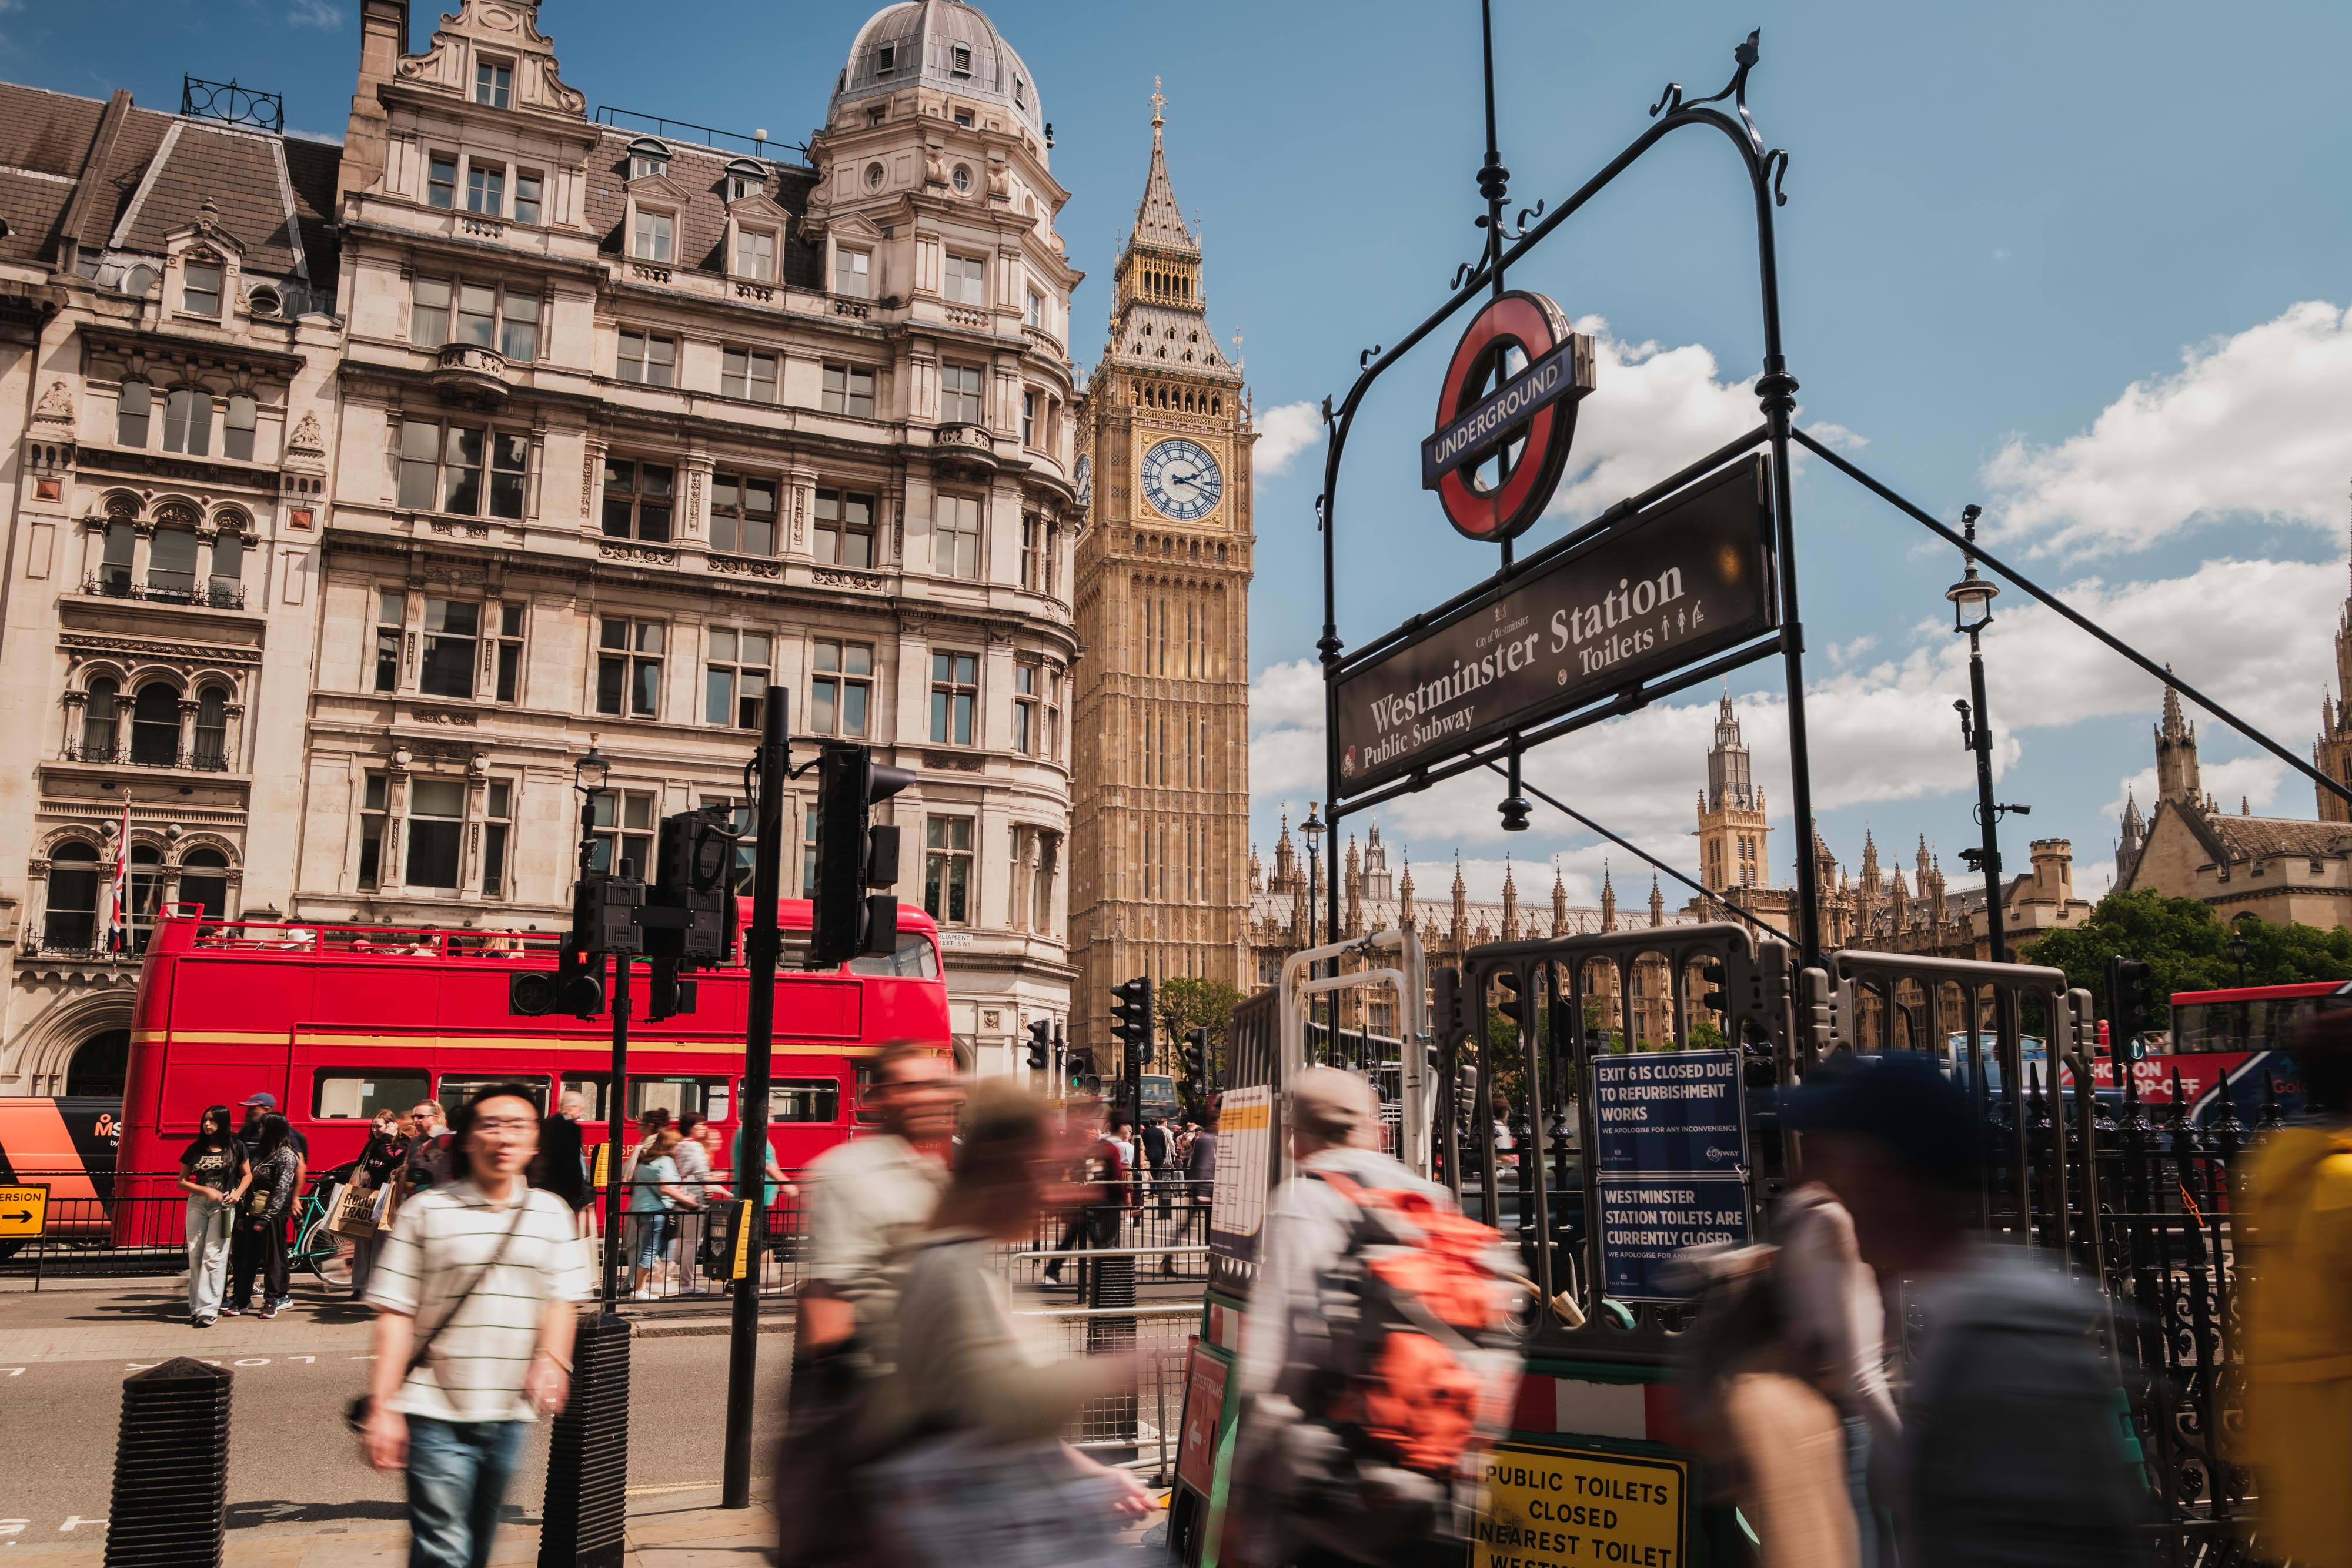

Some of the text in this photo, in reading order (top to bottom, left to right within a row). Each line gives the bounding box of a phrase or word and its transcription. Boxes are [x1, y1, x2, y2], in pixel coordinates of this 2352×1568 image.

[1435, 365, 1558, 464] UNDERGROUND
[1476, 616, 1529, 648] City of Westminster
[1371, 567, 1685, 734] Westminster Station
[1579, 628, 1654, 676] Toilets
[1364, 706, 1475, 769] Public Subway
[1599, 1062, 1733, 1081] EXIT 6 IS CLOSED DUE
[1600, 1084, 1726, 1101] TO REFURBISHMENT
[1601, 1106, 1648, 1121] WORKS
[193, 1162, 227, 1171] GOO
[199, 1155, 224, 1164] FEEL
[1605, 1190, 1695, 1204] WESTMINSTER
[1606, 1210, 1742, 1225] STATION TOILETS ARE
[1607, 1231, 1678, 1245] CURRENTLY
[1192, 1371, 1224, 1399] PEDESTRIANS
[1485, 1465, 1668, 1505] PUBLIC TOILETS
[1529, 1500, 1617, 1529] CLOSED
[1479, 1523, 1579, 1554] NEAREST
[1592, 1539, 1671, 1567] TOILET
